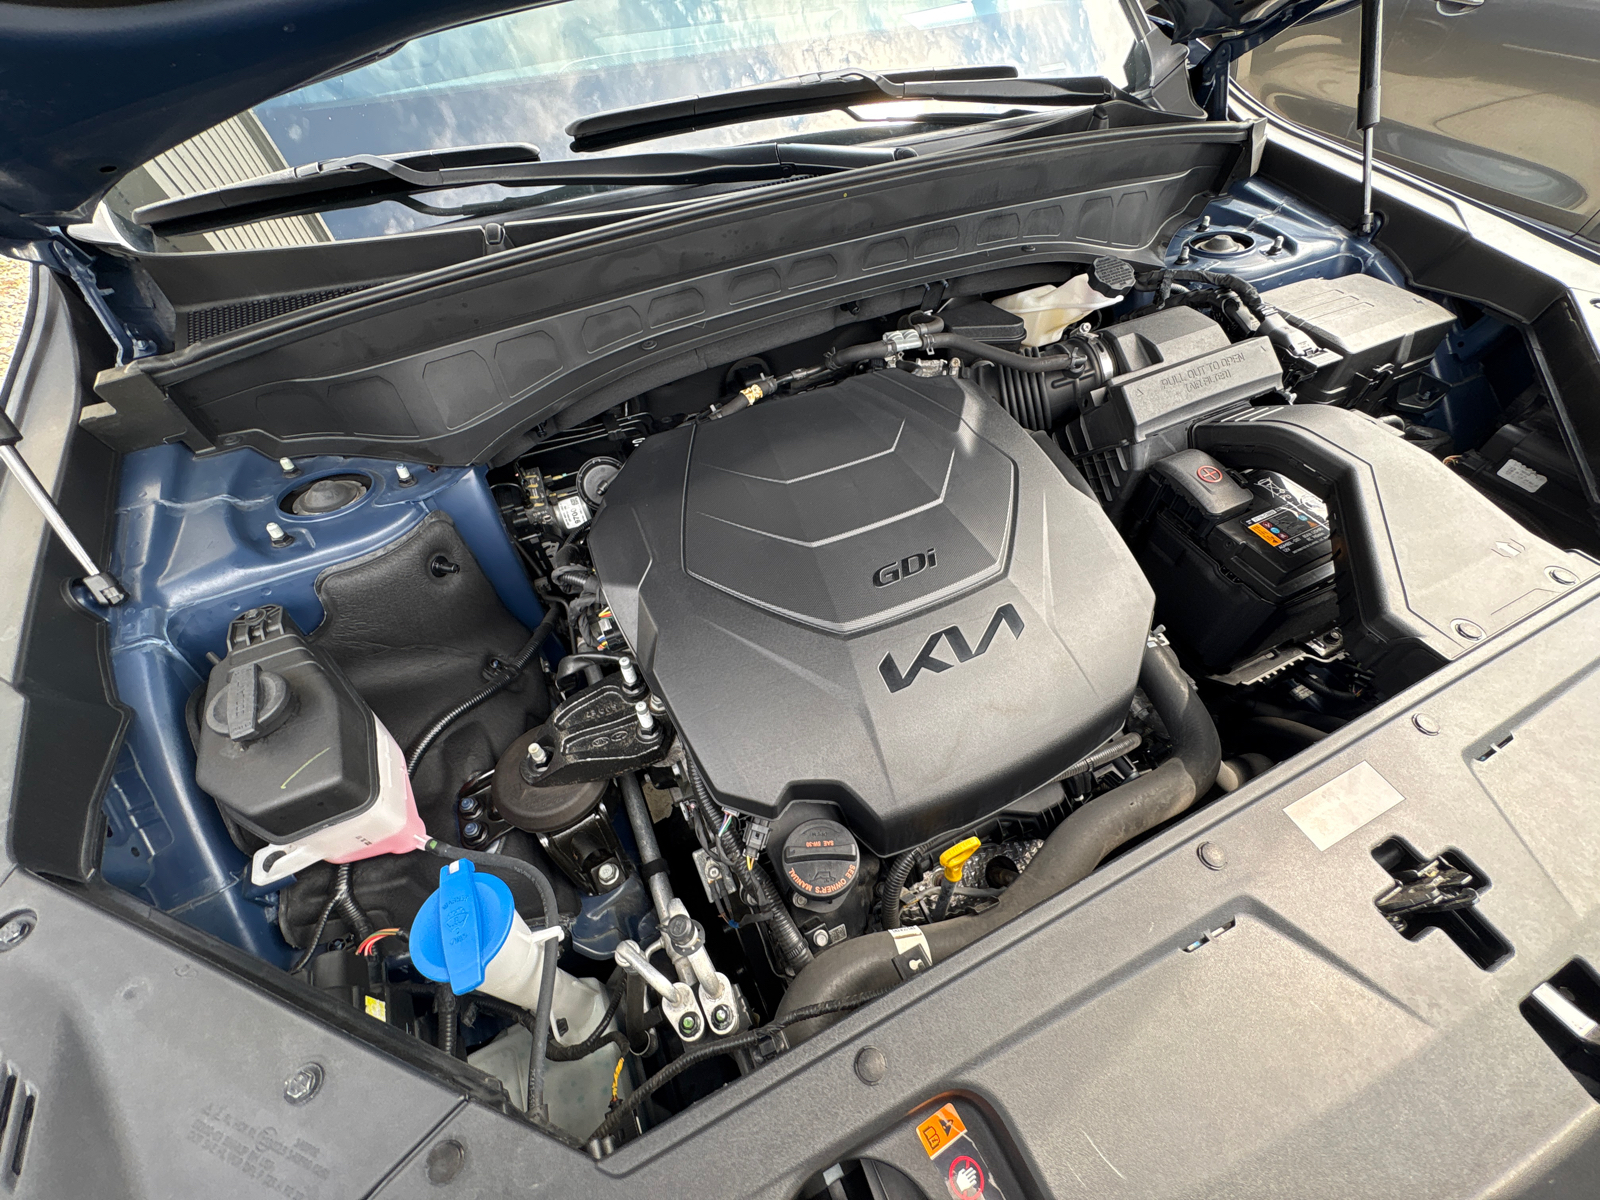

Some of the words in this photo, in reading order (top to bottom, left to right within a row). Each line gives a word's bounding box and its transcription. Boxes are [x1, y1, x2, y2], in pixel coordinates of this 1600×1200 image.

[1161, 372, 1187, 390] PULL
[1187, 366, 1206, 380] OUT
[1207, 360, 1220, 373] TO
[1221, 352, 1246, 368] OPEN
[872, 547, 938, 588] GDi
[878, 602, 1025, 694] KIA
[788, 867, 813, 892] MANUAL
[814, 878, 847, 894] OWNER'S
[845, 864, 856, 879] SEE
